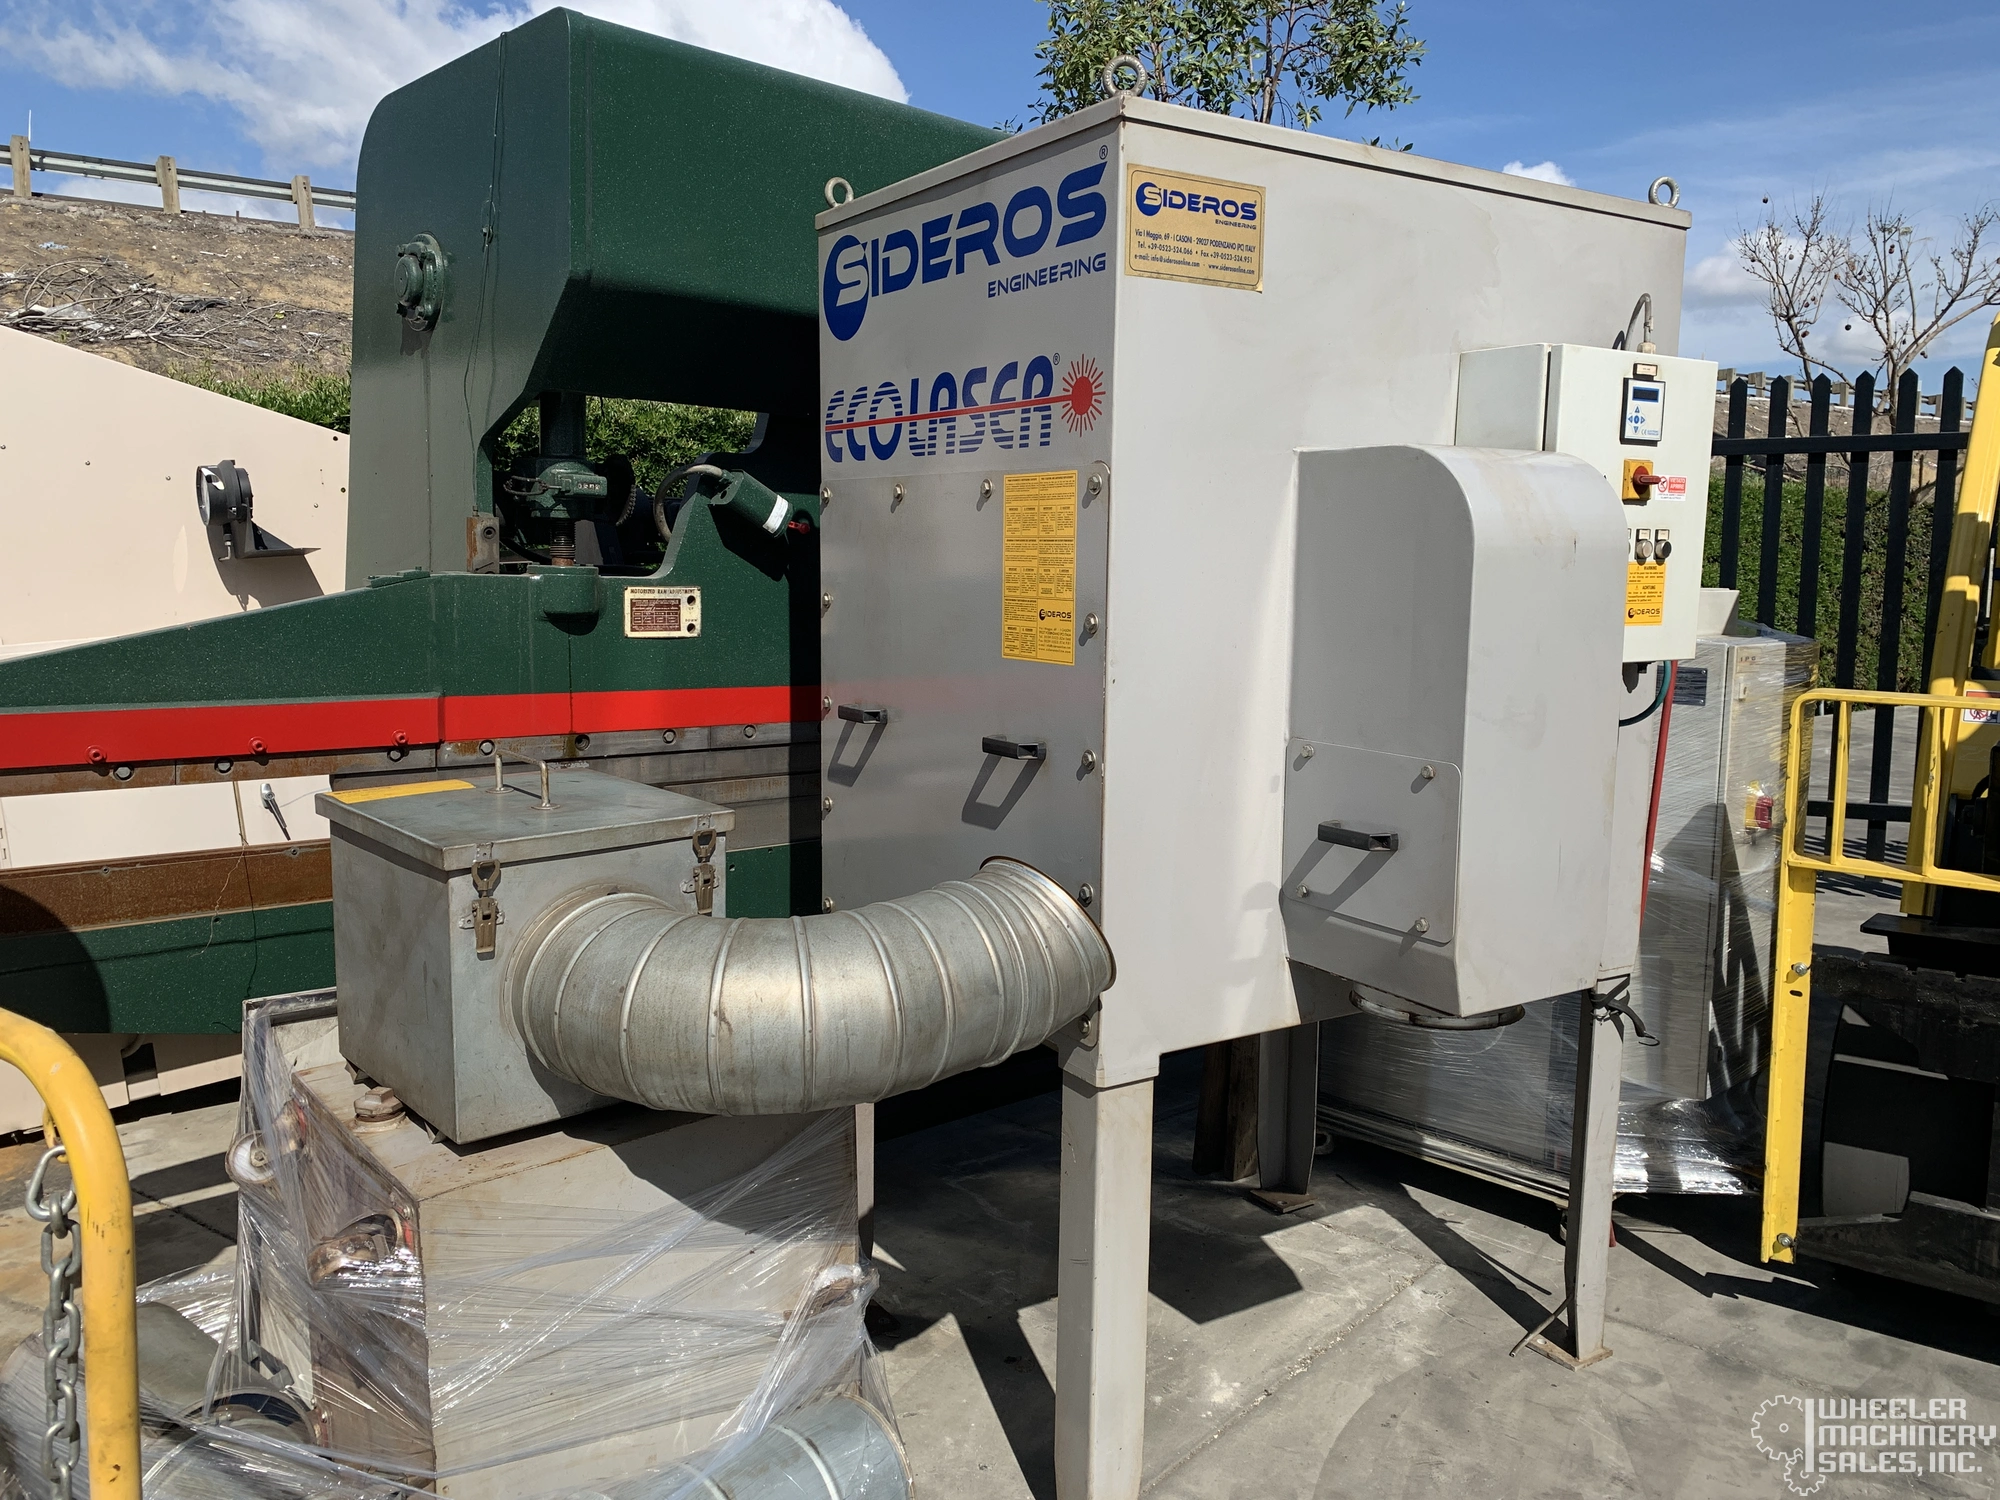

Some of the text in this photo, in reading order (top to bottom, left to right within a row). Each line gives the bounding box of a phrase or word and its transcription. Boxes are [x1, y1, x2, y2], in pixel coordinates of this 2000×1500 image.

[1136, 183, 1257, 221] SIDEROS
[826, 161, 1107, 322] SIDEROS
[1135, 228, 1143, 236] Via
[1214, 219, 1257, 230] ENGINEERING
[988, 253, 1106, 298] ENGINEERING
[825, 356, 1054, 463] ECOLASER
[1039, 609, 1072, 620] SIDEROS
